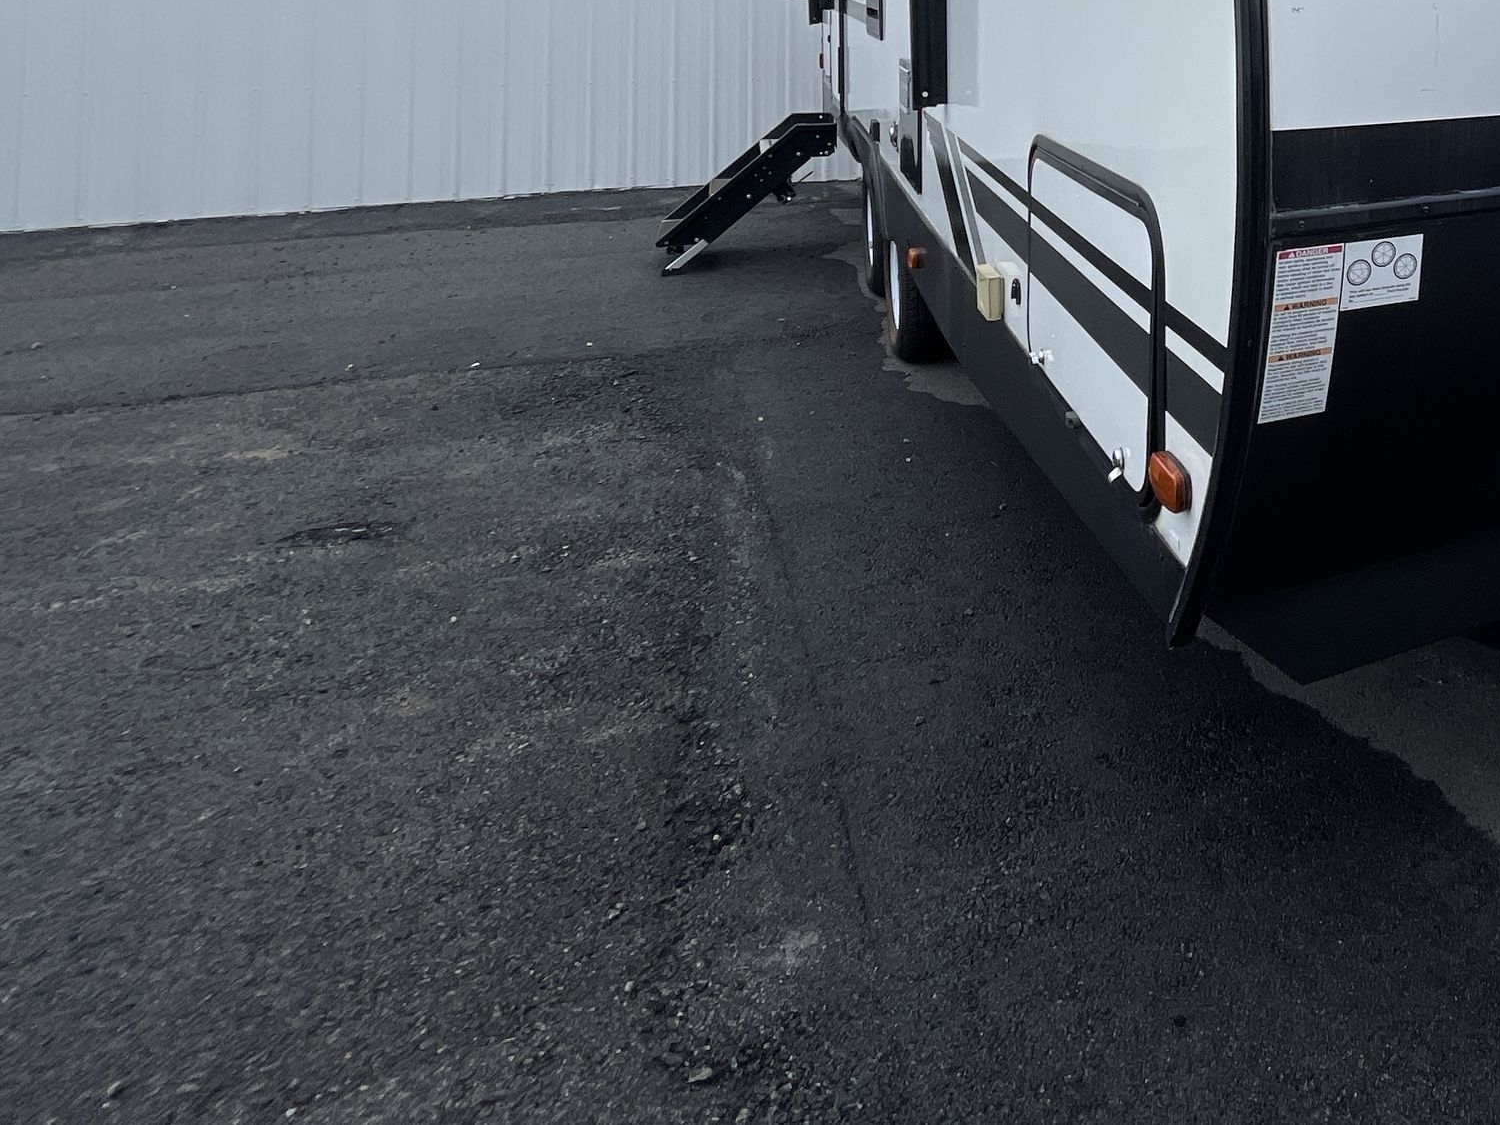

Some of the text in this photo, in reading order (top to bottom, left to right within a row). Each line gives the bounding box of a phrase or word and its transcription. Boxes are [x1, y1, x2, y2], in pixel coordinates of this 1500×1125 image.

[1296, 247, 1329, 258] DANGER
[1292, 299, 1327, 310] WARNING
[1286, 349, 1322, 360] WARNING
